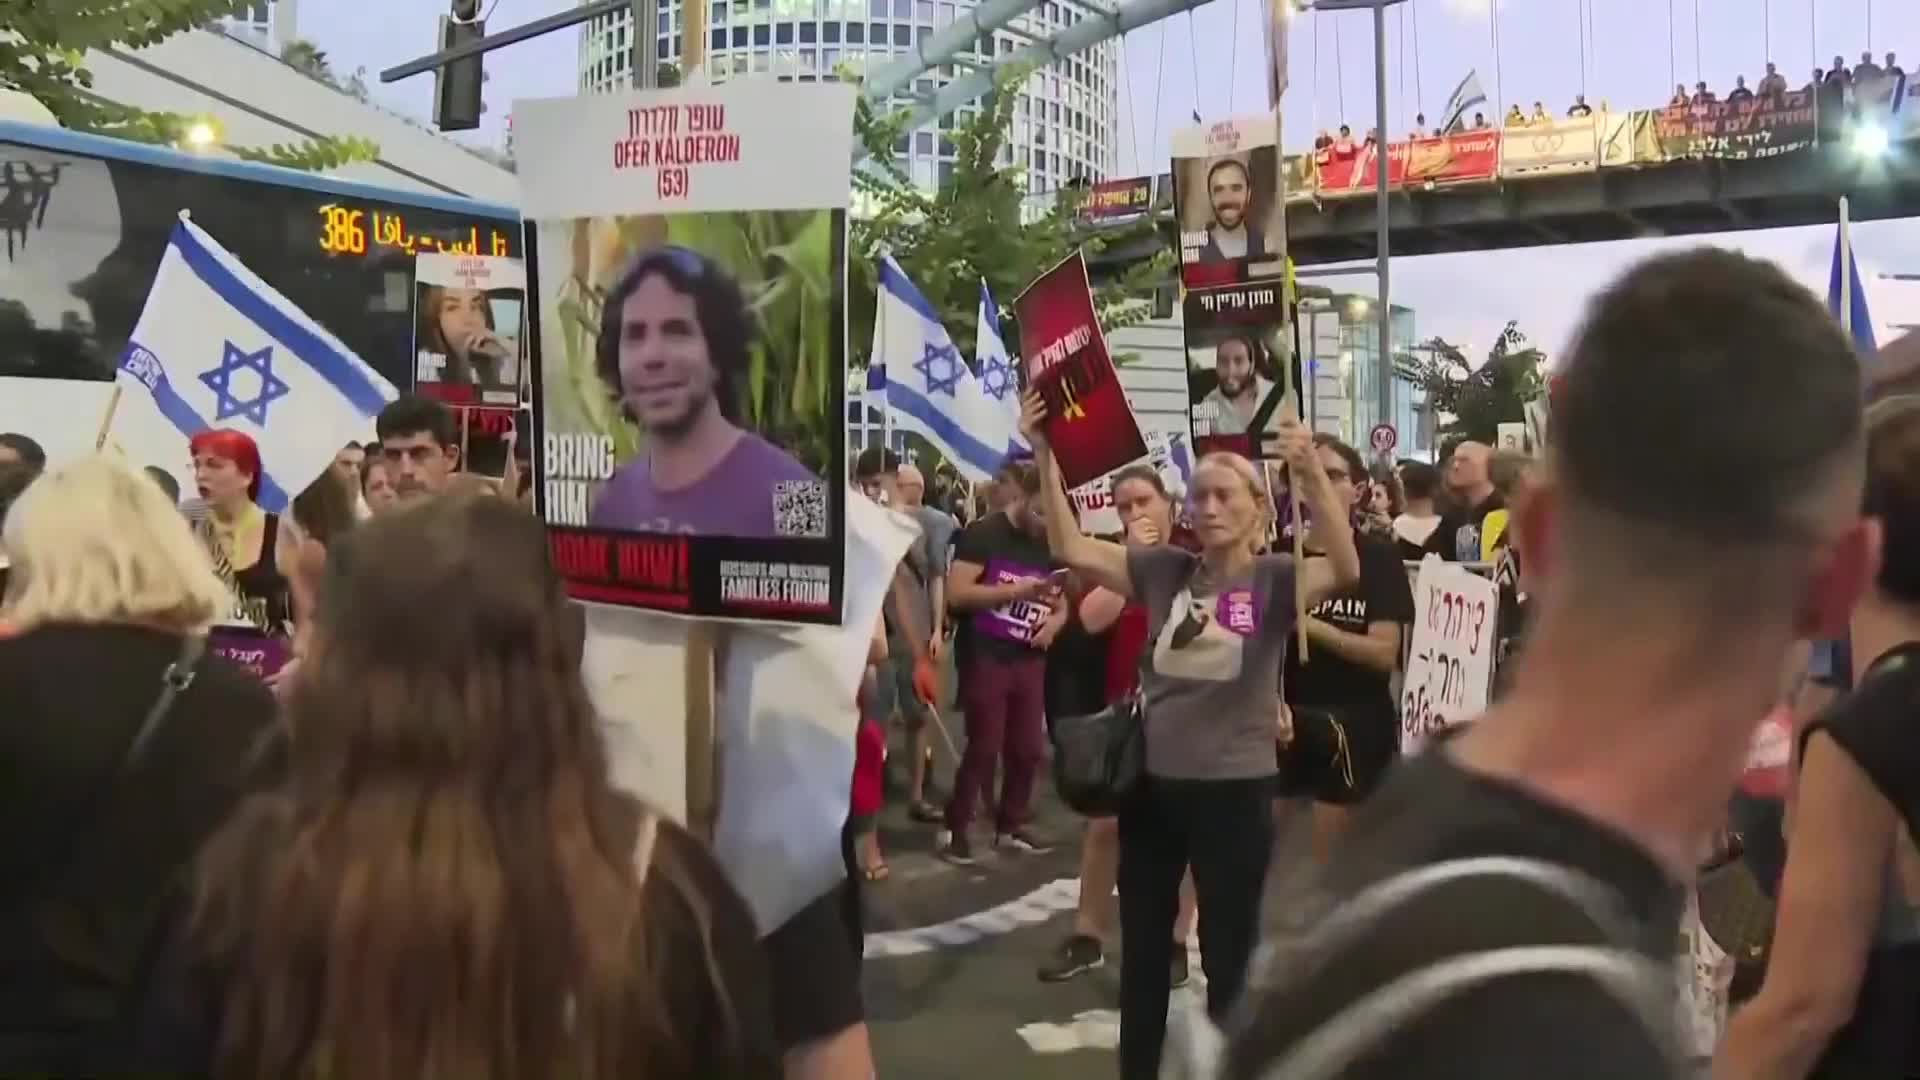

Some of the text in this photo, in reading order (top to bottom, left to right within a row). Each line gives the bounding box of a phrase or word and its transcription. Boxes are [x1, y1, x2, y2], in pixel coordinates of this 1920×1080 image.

[628, 104, 725, 138] עופר קלדרון
[614, 135, 740, 168] OFER KALDERON
[657, 167, 689, 199] (53)
[319, 203, 365, 254] 386
[545, 432, 616, 480] BRING
[545, 480, 587, 527] HIM
[720, 577, 831, 605] FAMILIES FORUM
